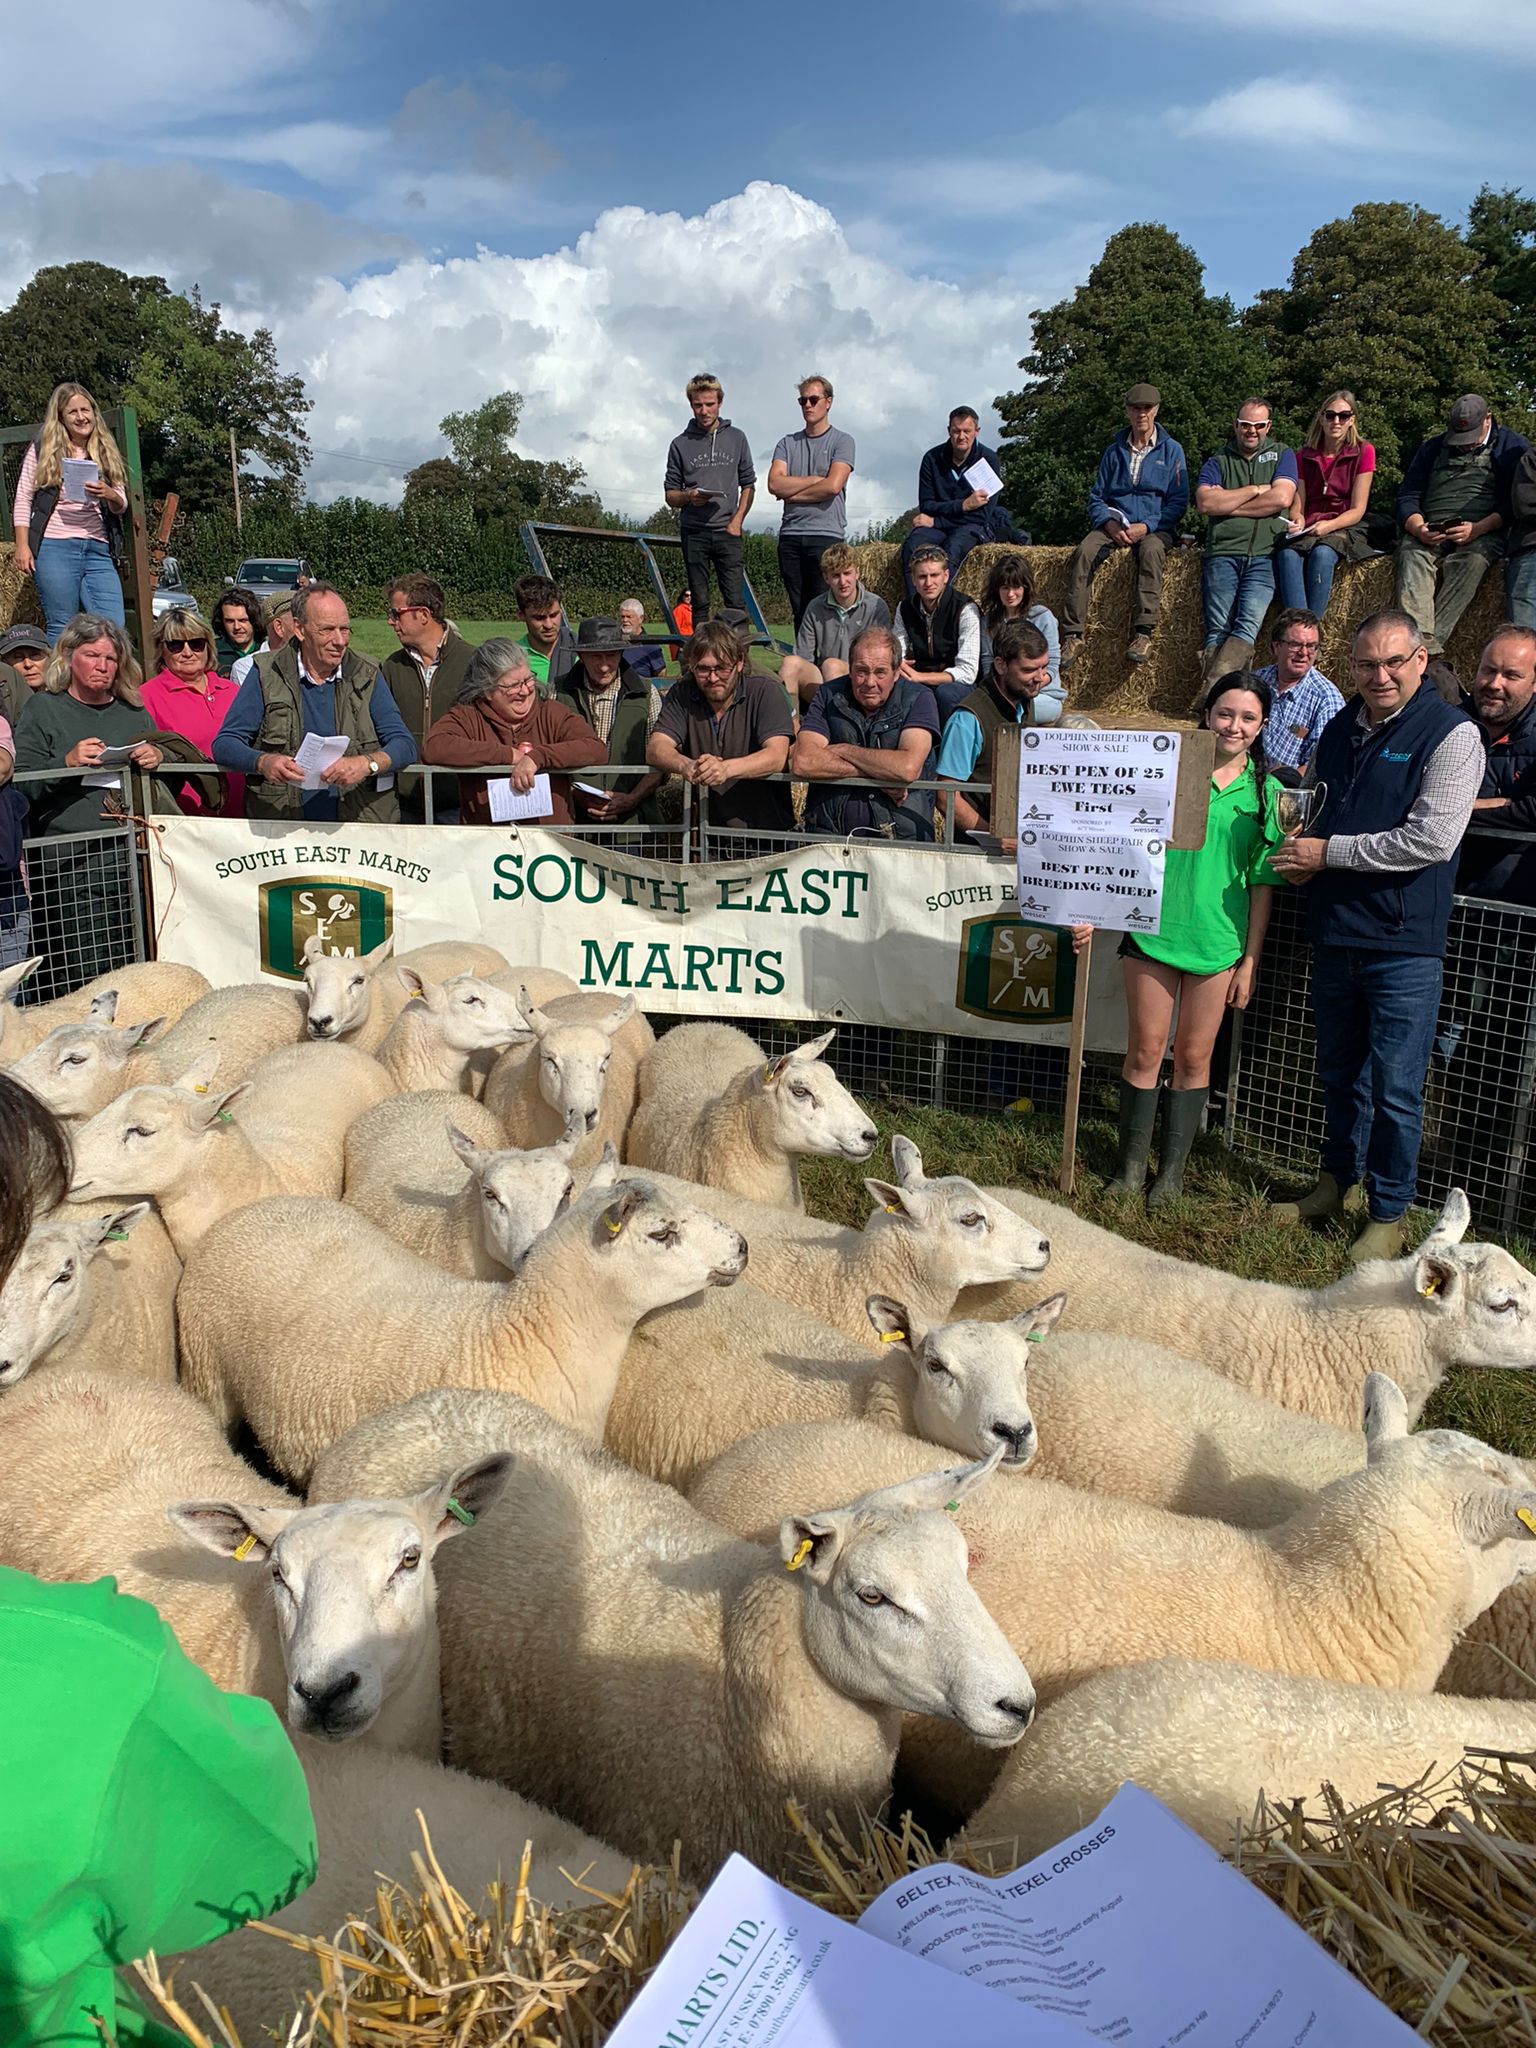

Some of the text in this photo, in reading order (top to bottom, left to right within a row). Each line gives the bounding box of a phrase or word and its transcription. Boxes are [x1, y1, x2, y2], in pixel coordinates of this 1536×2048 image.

[1044, 732, 1089, 742] DOLPHIN
[1091, 734, 1124, 742] SHEEP
[1126, 734, 1149, 742] FAIR
[1062, 744, 1092, 752] SHOW
[1104, 744, 1129, 753] SALE
[1026, 763, 1164, 779] BEST PEN OF 25
[1051, 781, 1137, 796] EWE TEGS
[1023, 813, 1054, 821] ACT
[1075, 801, 1113, 813] First
[1130, 817, 1164, 825] ACT
[1041, 832, 1085, 844] DOLPHIN
[1086, 835, 1119, 845] SHEEP
[1121, 837, 1143, 847] FAIR
[1058, 844, 1088, 853] SHOW
[1099, 846, 1124, 855] SALE
[215, 846, 432, 883] SOUTH EAST MARTS
[1041, 861, 1139, 878] BEST PEN OF
[492, 853, 869, 918] SOUTH EAST
[1022, 876, 1157, 898] BREEDING SHEEP
[926, 885, 993, 912] SOUTH
[1021, 901, 1051, 911] ACT
[299, 892, 317, 915] S
[317, 918, 332, 940] E
[1124, 913, 1157, 923] ACT
[579, 939, 786, 996] MARTS
[999, 929, 1050, 1009] S E M
[896, 1875, 960, 1909] BELTEX,
[1005, 1872, 1053, 1898] TEXEL
[1052, 1825, 1116, 1874] CROSSES
[901, 1904, 942, 1934] WILLIAMS
[919, 1926, 968, 1957] WOOLSTON
[657, 1919, 766, 2048] MARTS LTD.
[730, 1982, 764, 2030] SUSSEX
[760, 1951, 783, 1981] BN27
[779, 1926, 799, 1951] 2AG
[750, 1995, 775, 2030] 07890
[771, 1954, 802, 1996] 359622
[759, 1940, 832, 2048] southeastmarts.co.uk
